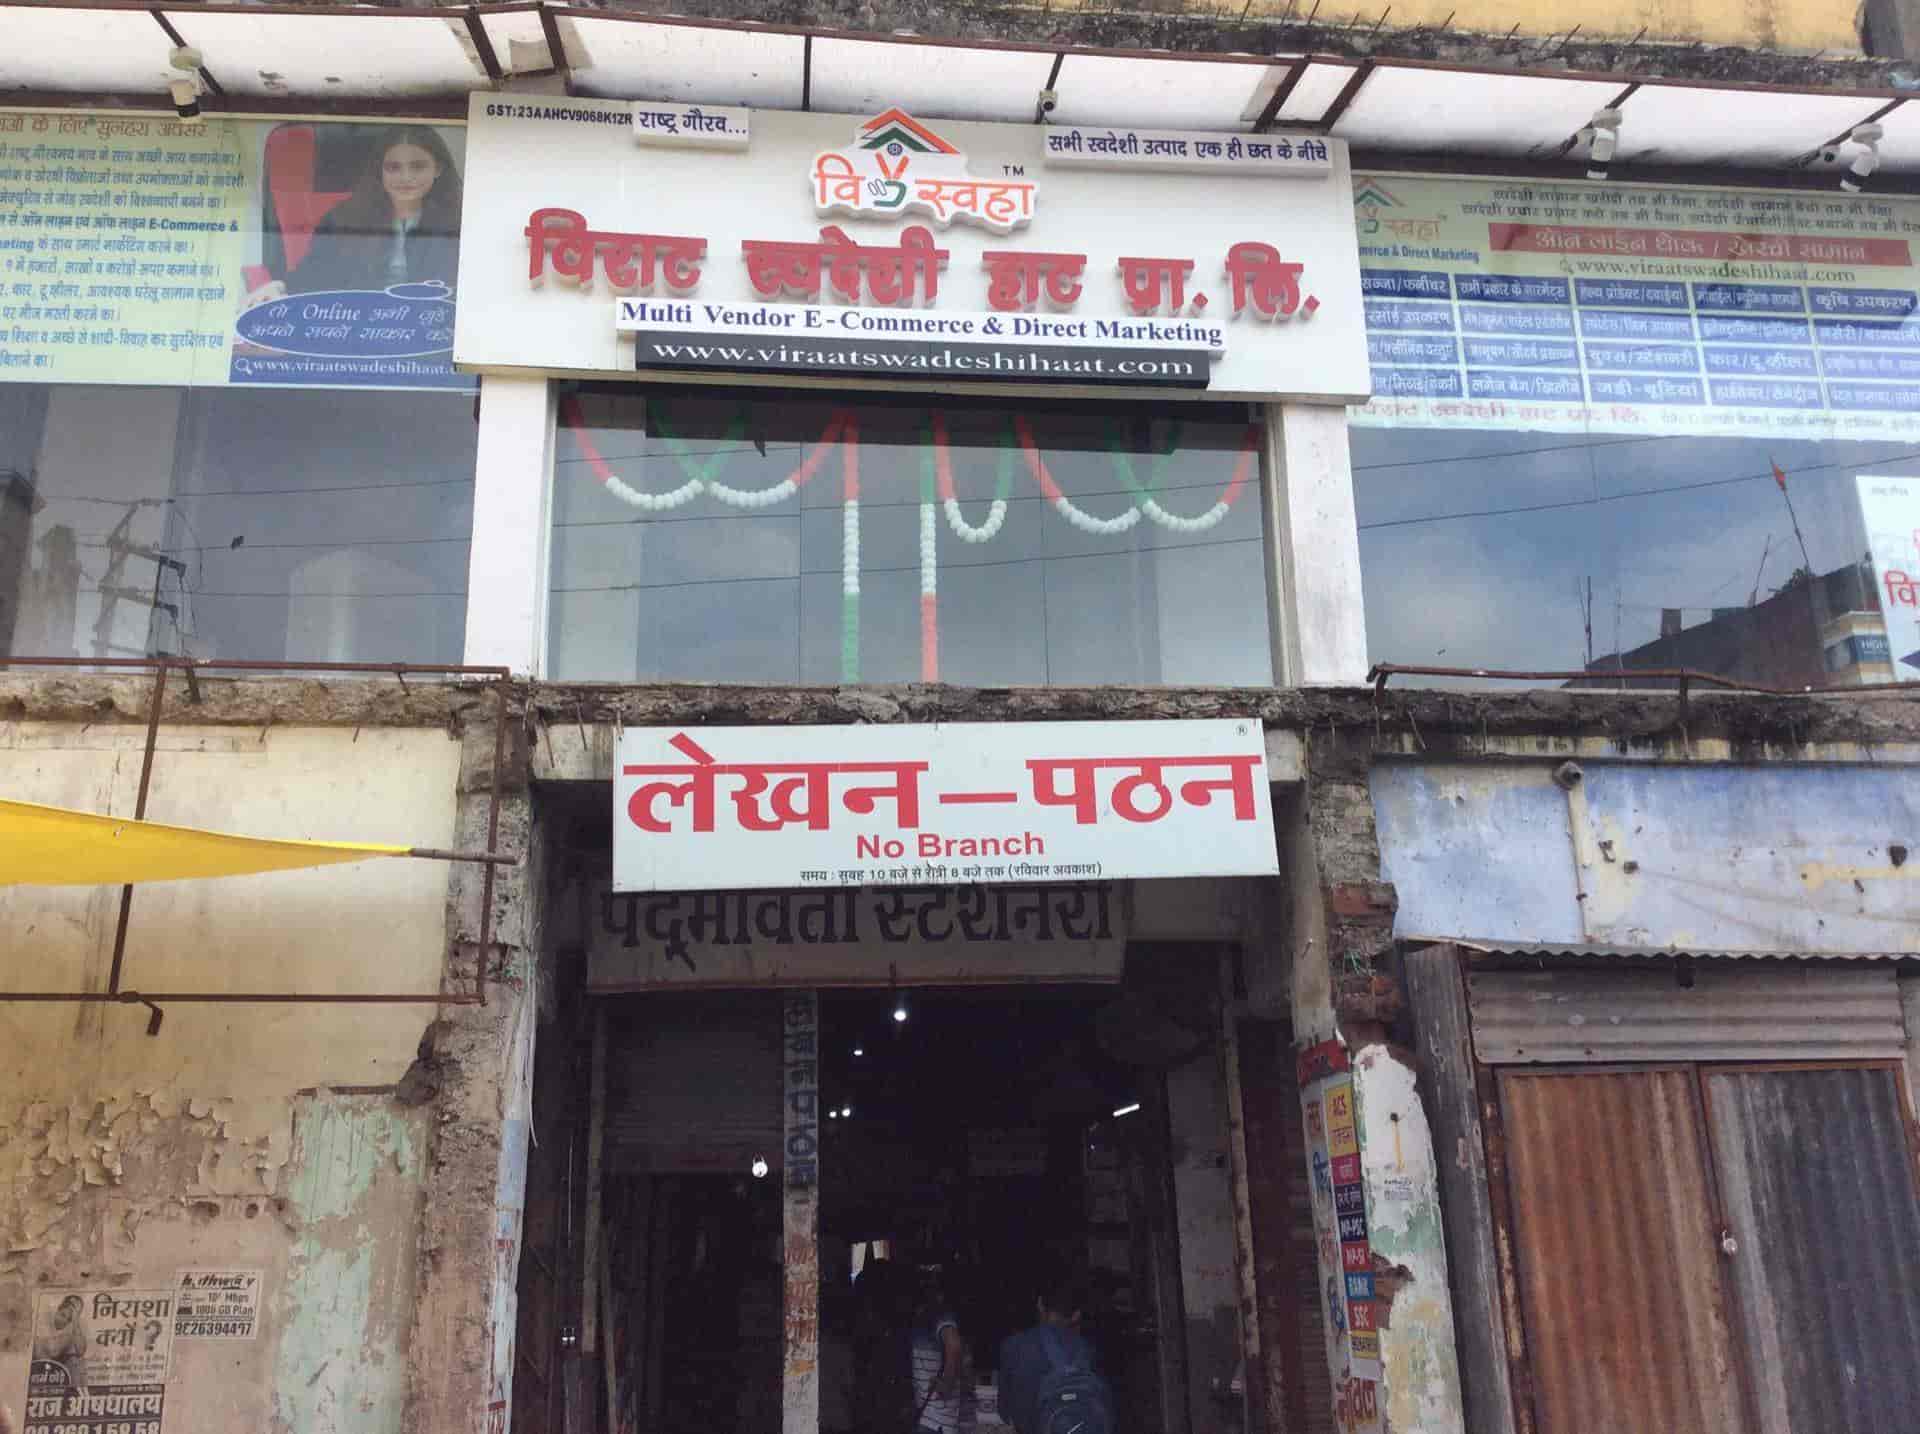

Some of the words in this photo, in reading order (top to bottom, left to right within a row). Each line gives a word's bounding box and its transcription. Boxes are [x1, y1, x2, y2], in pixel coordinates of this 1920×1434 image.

[638, 111, 679, 134] राष्ट्र
[1049, 133, 1083, 154] सभी
[1087, 131, 1138, 155] स्वदेशी
[1143, 138, 1187, 157] उत्पाद
[1195, 141, 1222, 159] एक
[1226, 137, 1243, 159] ही
[1247, 140, 1273, 161] छत
[1277, 137, 1292, 160] के
[1298, 137, 1327, 162] नीचे
[1003, 165, 1024, 177] TM
[149, 217, 227, 233] E-Commerce
[525, 207, 708, 290] विराट
[741, 223, 950, 304] स्वदेशी
[982, 249, 1088, 311] हाट
[1118, 256, 1209, 313] प्रा.
[1225, 241, 1321, 316] लि.
[302, 302, 361, 321] Online
[621, 301, 692, 324] Multi
[704, 305, 796, 329] Vendor
[804, 309, 975, 334] E-Commerce
[981, 318, 1003, 335] &
[1013, 318, 1088, 339] Direct
[1095, 319, 1224, 346] Marketing
[652, 340, 1194, 376] www.viraatswadeshihaat.com
[1025, 755, 1262, 825] पठन
[857, 835, 905, 859] No
[918, 832, 1045, 858] Branch
[870, 869, 886, 881] 10
[951, 868, 960, 879] 8
[92, 1293, 170, 1319] निराशा
[232, 1304, 254, 1316] Plan
[96, 1322, 137, 1347] क्यों
[144, 1320, 162, 1351] ?
[28, 1396, 62, 1418] राज
